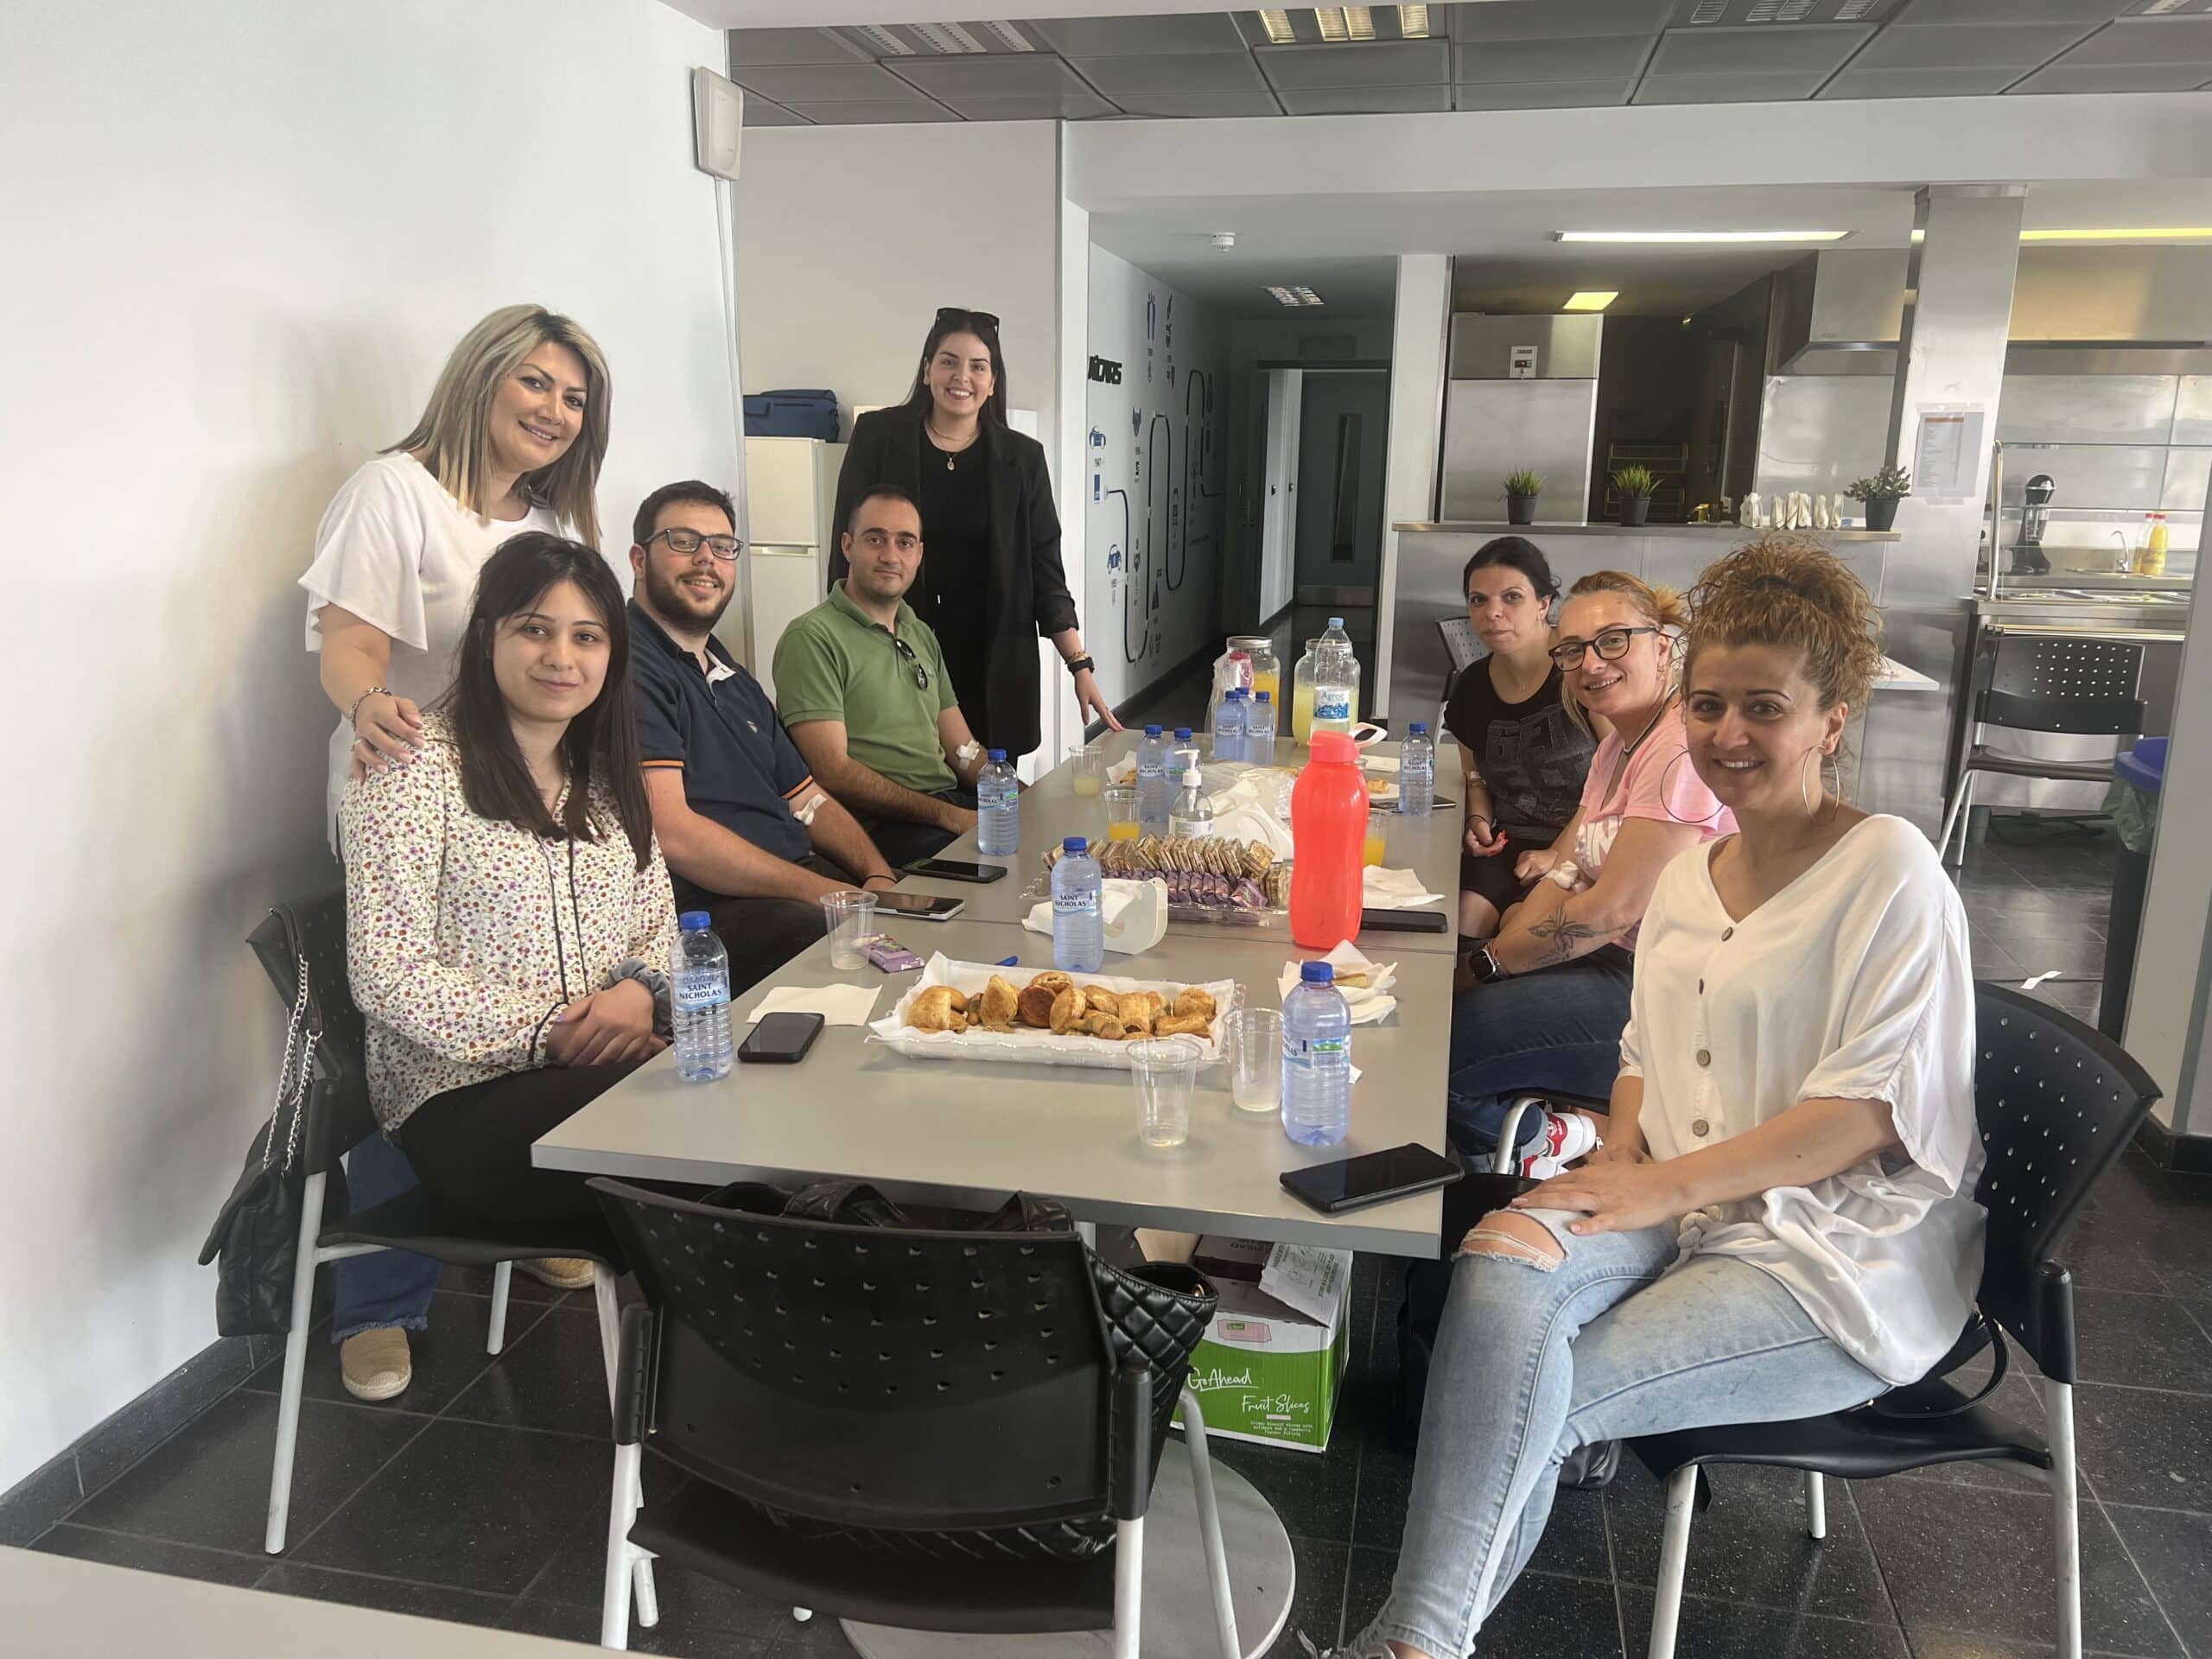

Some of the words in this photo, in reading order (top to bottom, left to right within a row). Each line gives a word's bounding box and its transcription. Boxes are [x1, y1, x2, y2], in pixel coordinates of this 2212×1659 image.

[1054, 899, 1087, 908] NICHOLAS
[688, 982, 711, 992] SAINT
[680, 989, 721, 1000] NICHOLAS
[1242, 1394, 1274, 1413] Fruit
[1275, 1393, 1311, 1414] Slices
